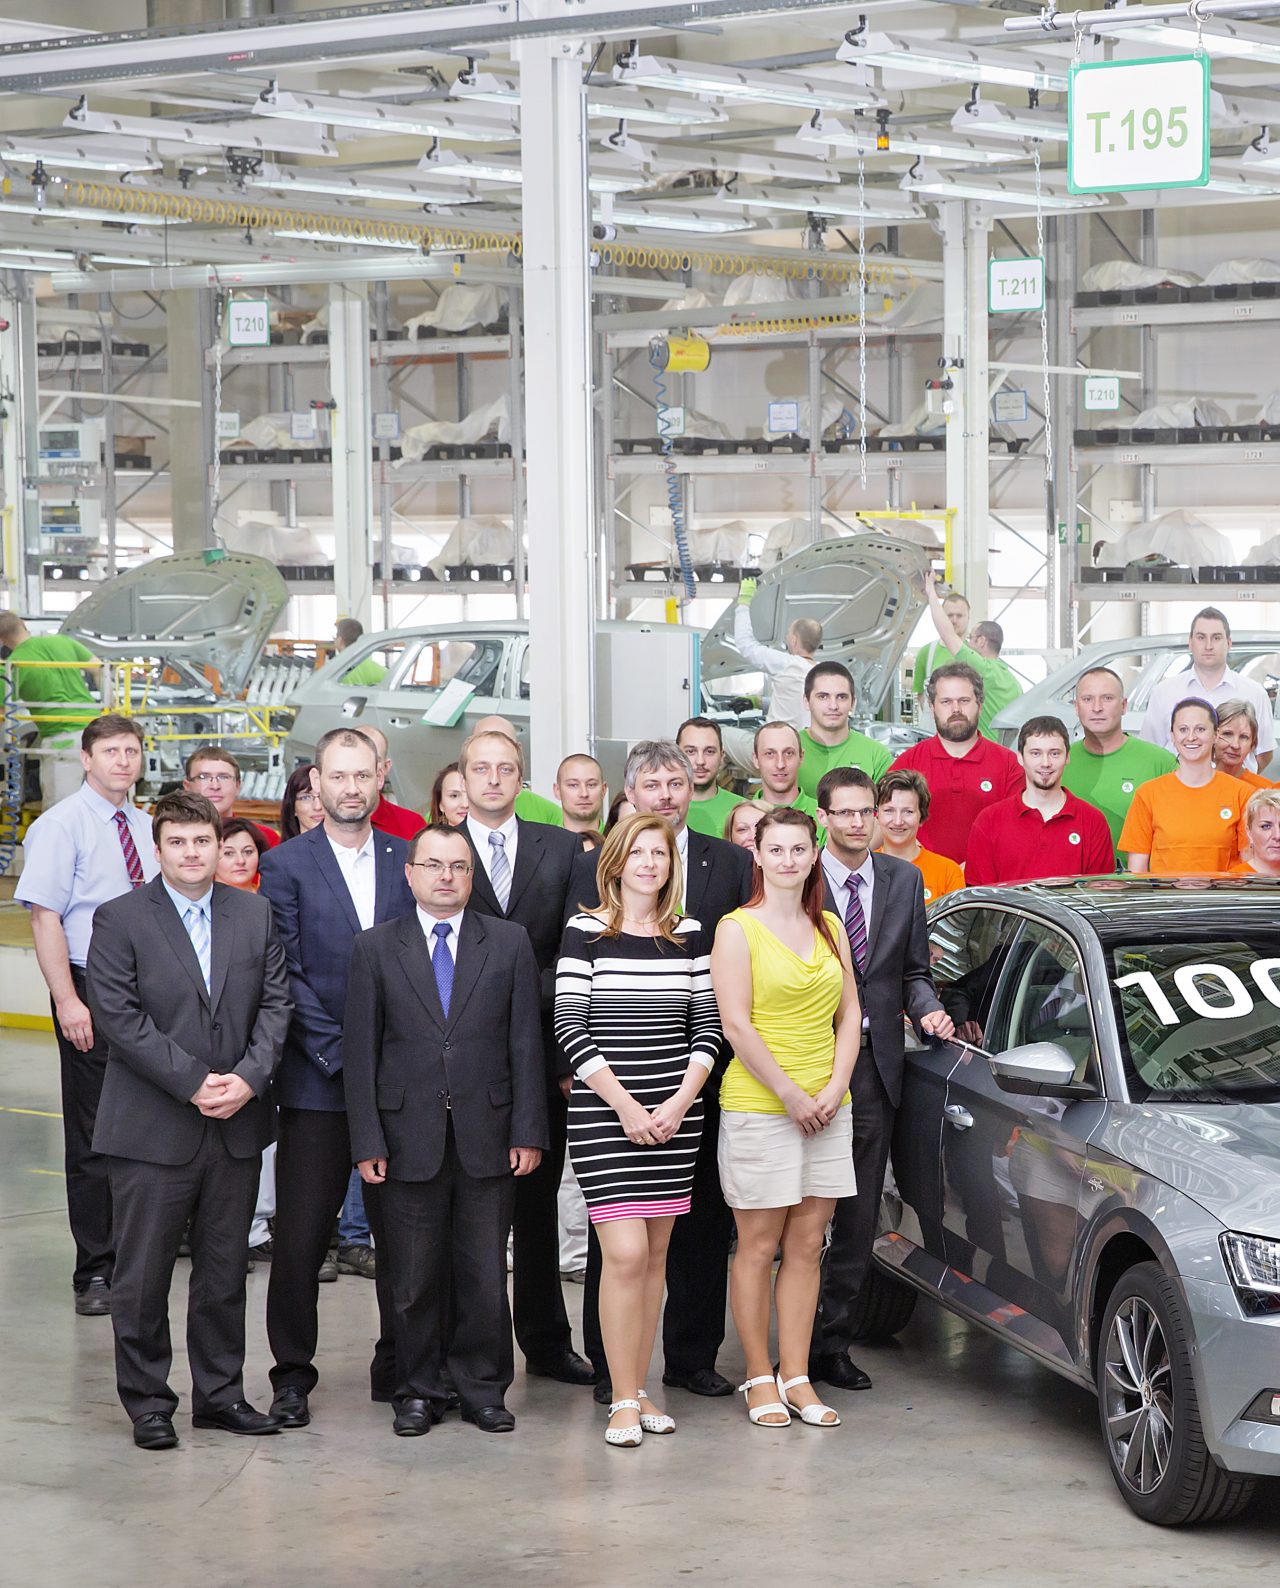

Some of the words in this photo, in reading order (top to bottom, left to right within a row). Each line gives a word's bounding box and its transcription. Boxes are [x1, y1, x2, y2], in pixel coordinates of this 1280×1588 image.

[1086, 106, 1188, 153] T.195
[998, 276, 1036, 296] T.211
[235, 316, 265, 332] T.210
[1089, 389, 1115, 401] T.210
